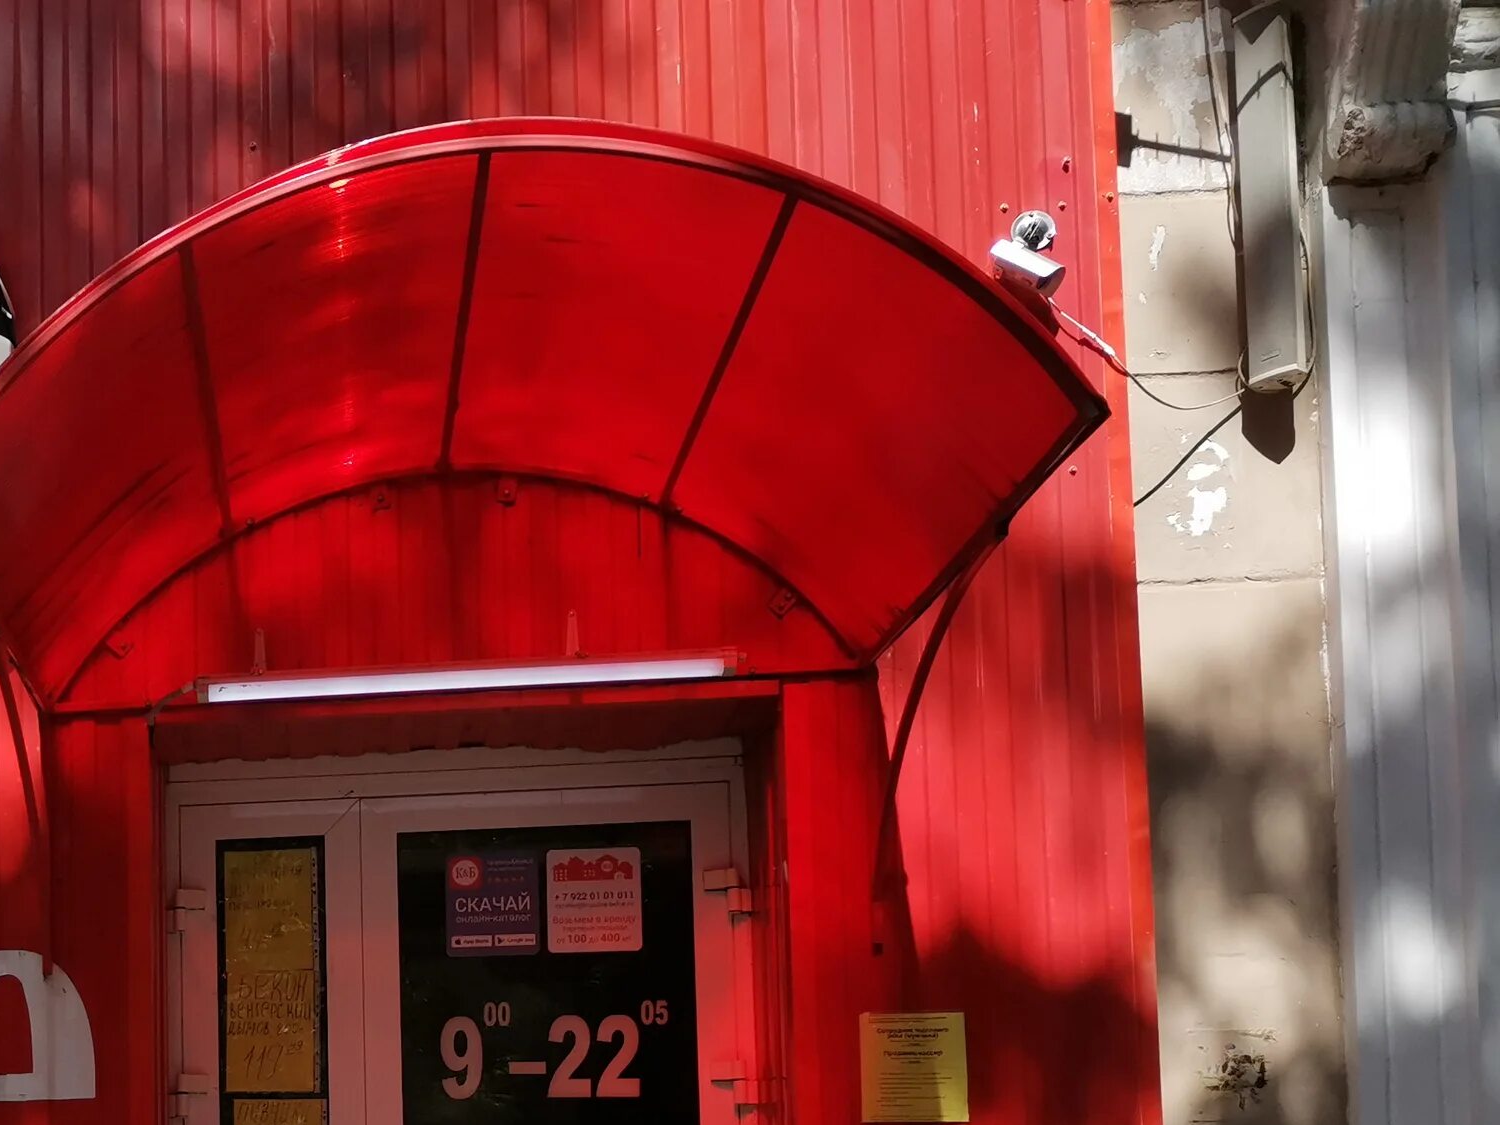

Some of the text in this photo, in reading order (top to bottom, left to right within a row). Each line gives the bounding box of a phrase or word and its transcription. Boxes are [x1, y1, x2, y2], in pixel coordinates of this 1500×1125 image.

[455, 866, 476, 880] К&Б
[455, 891, 530, 912] СКАЧАЙ
[562, 892, 569, 901] 7
[570, 892, 587, 901] 922
[589, 891, 600, 900] 01
[603, 891, 614, 900] 01
[617, 890, 634, 899] 011
[568, 933, 587, 943] 100
[600, 932, 620, 942] 400
[440, 1016, 484, 1100] 9
[483, 1001, 511, 1027] 00
[641, 1000, 669, 1026] 05
